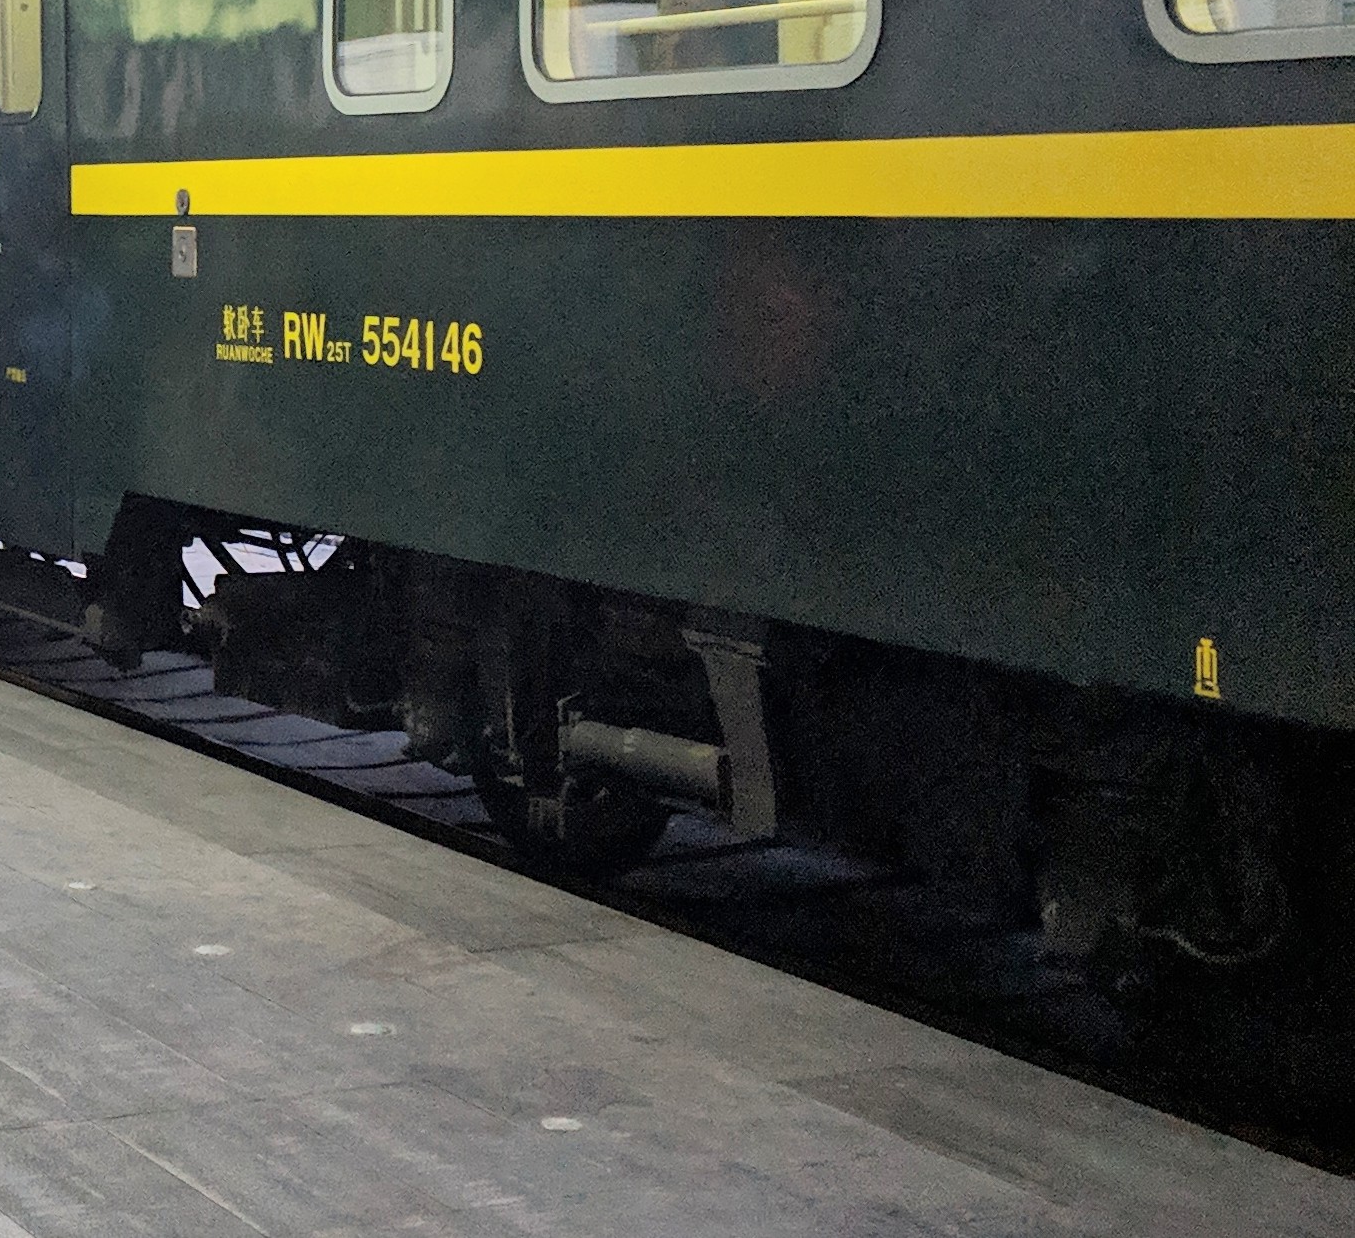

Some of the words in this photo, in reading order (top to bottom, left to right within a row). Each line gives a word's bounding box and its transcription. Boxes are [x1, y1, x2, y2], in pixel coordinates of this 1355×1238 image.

[222, 304, 265, 343] 软卧车
[216, 343, 274, 364] RUANWOCHE
[362, 315, 483, 375] 554146
